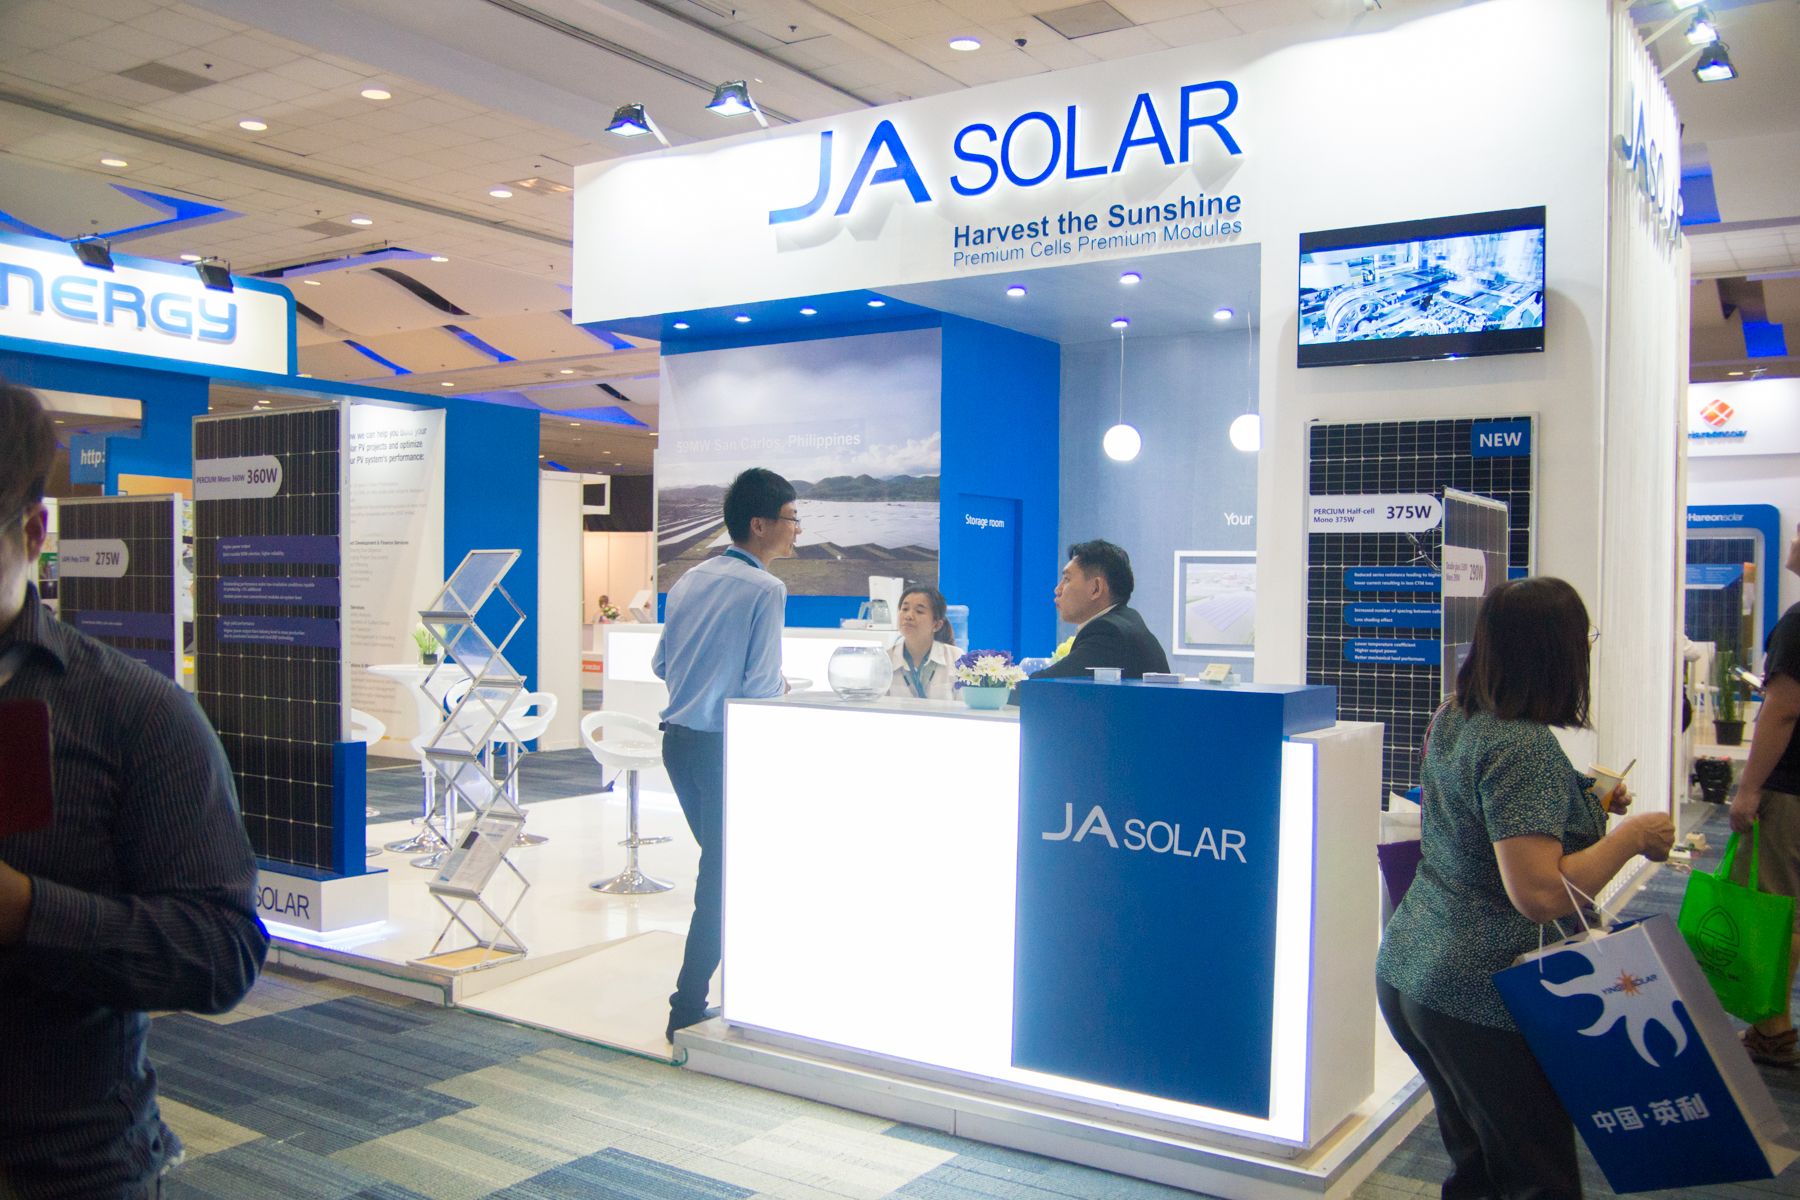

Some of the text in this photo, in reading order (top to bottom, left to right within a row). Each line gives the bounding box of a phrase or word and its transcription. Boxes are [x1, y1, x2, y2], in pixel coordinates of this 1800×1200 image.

[768, 80, 1243, 225] JA SOLAR
[954, 193, 1242, 248] Harvest the Sunshine
[953, 219, 1243, 267] Premium Cells Premium Modules
[788, 433, 861, 450] Philippines
[1479, 431, 1523, 448] NEW
[247, 468, 278, 485] 360W
[1224, 512, 1253, 526] Your
[1313, 507, 1375, 516] PERCIUM Half-cell
[1313, 516, 1355, 524] Mono 375W
[1386, 505, 1432, 520] 375W
[965, 513, 1005, 529] Storage room
[95, 551, 120, 566] 275W
[1042, 802, 1247, 864] JA SOLAR
[1591, 1092, 1711, 1134] 中国·英利
